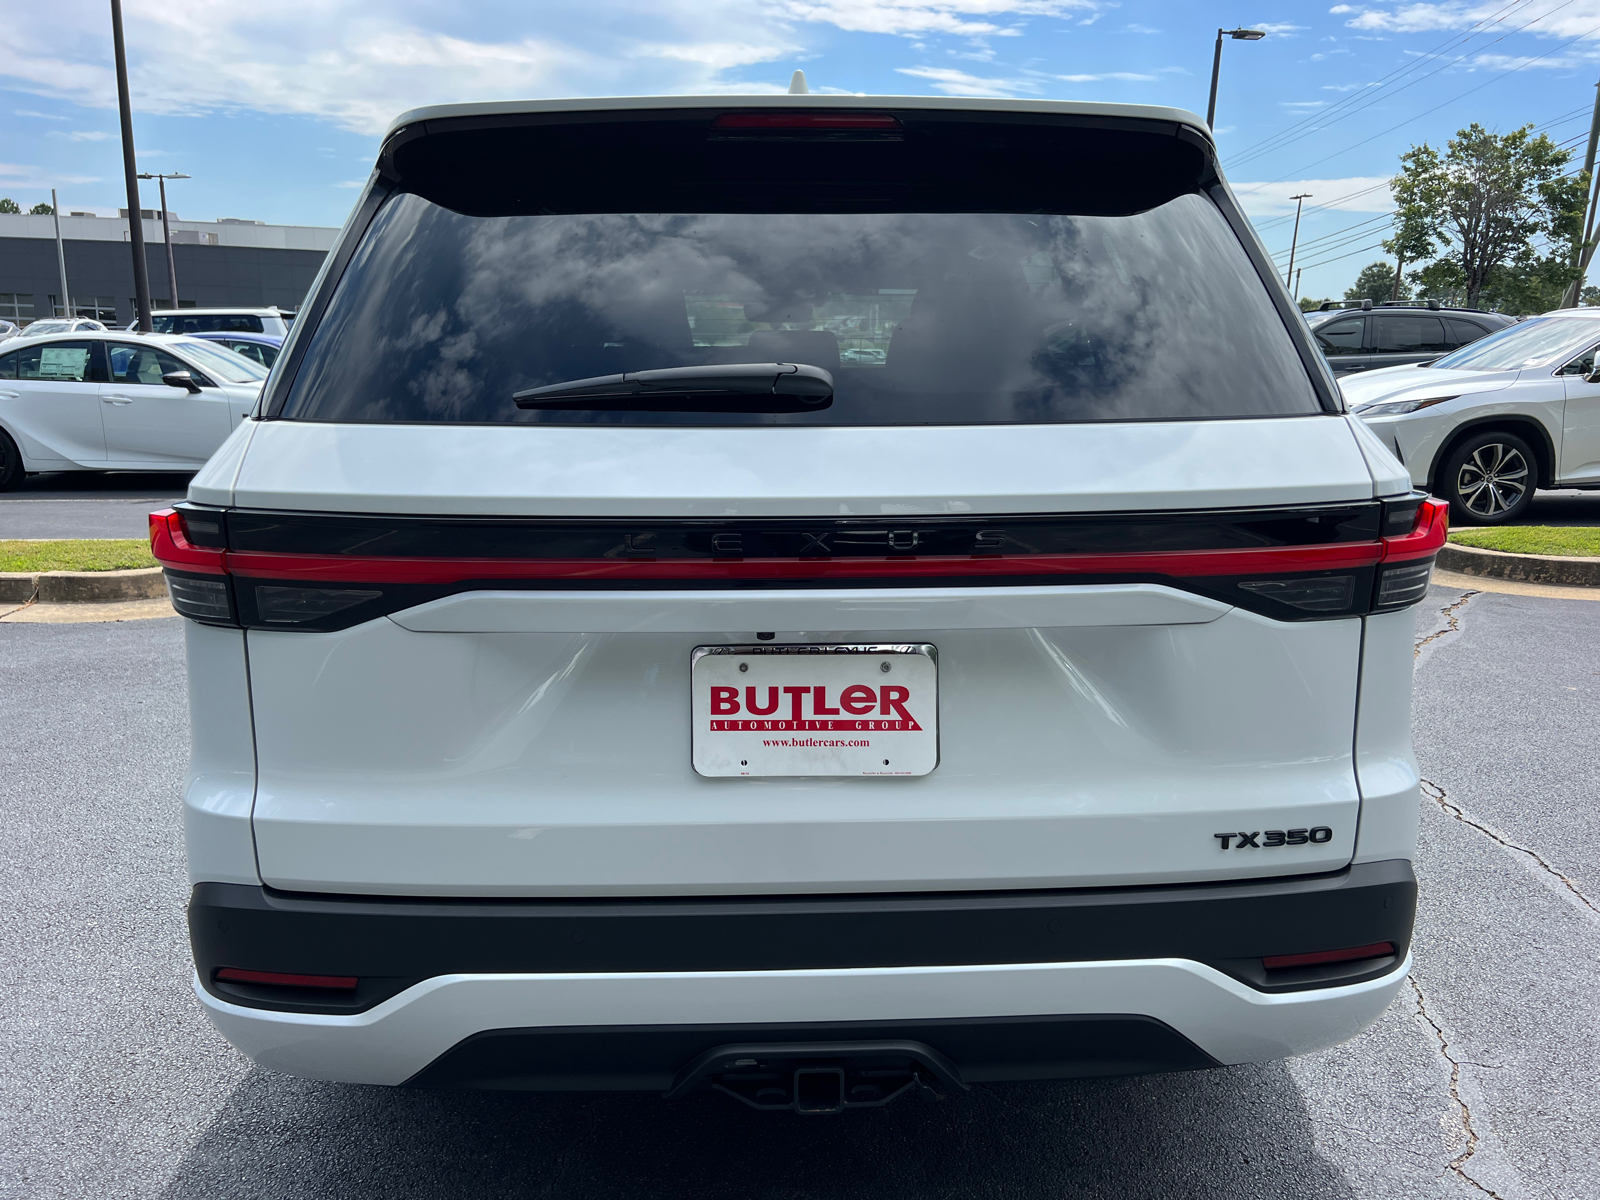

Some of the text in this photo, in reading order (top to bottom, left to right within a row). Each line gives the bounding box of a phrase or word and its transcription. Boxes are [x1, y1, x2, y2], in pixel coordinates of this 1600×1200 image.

[624, 530, 1007, 554] LEXUS
[711, 720, 915, 730] AUTOMOTIVE GROUP
[762, 737, 870, 748] www.butlercars.com
[1213, 825, 1333, 850] TX350
